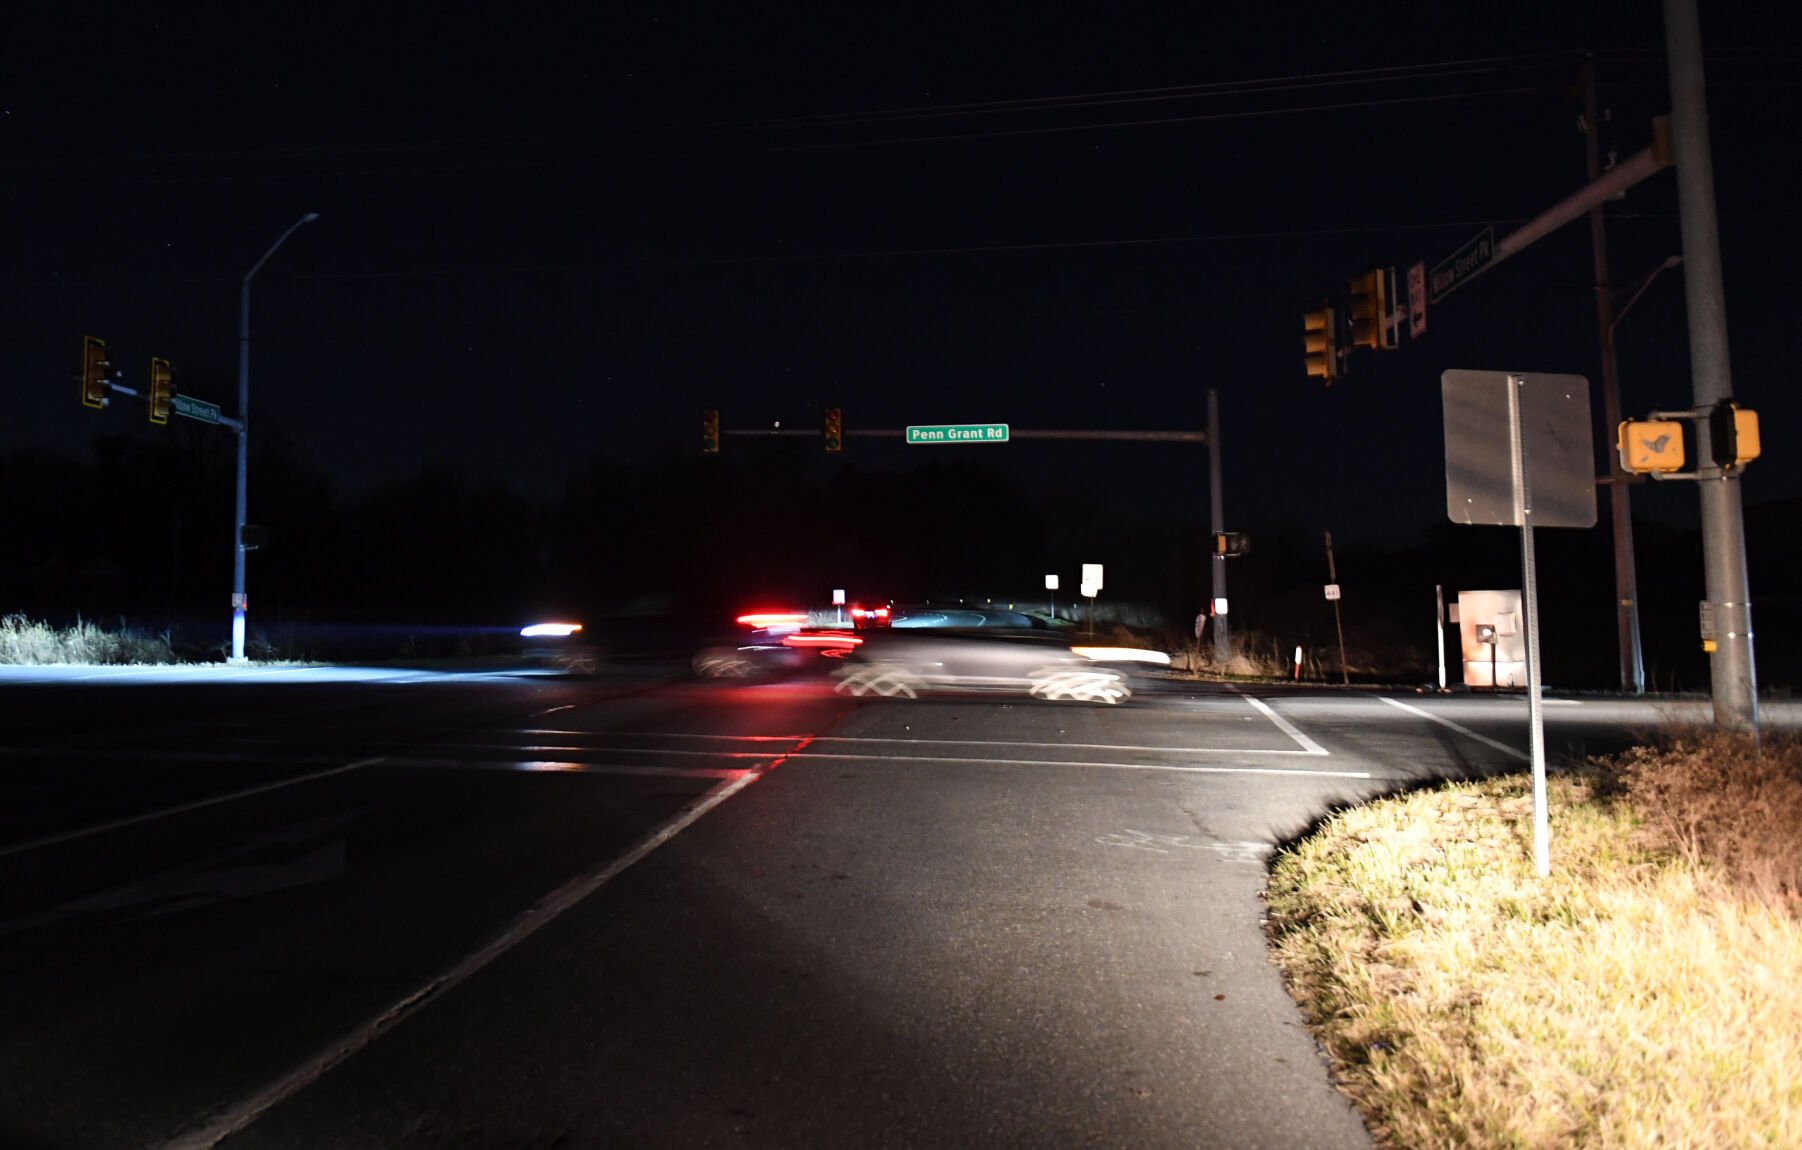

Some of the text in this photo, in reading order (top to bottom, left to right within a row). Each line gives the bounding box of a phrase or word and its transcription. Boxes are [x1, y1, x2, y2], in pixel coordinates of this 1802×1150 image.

[912, 427, 1003, 440] Penn Grant Rd
